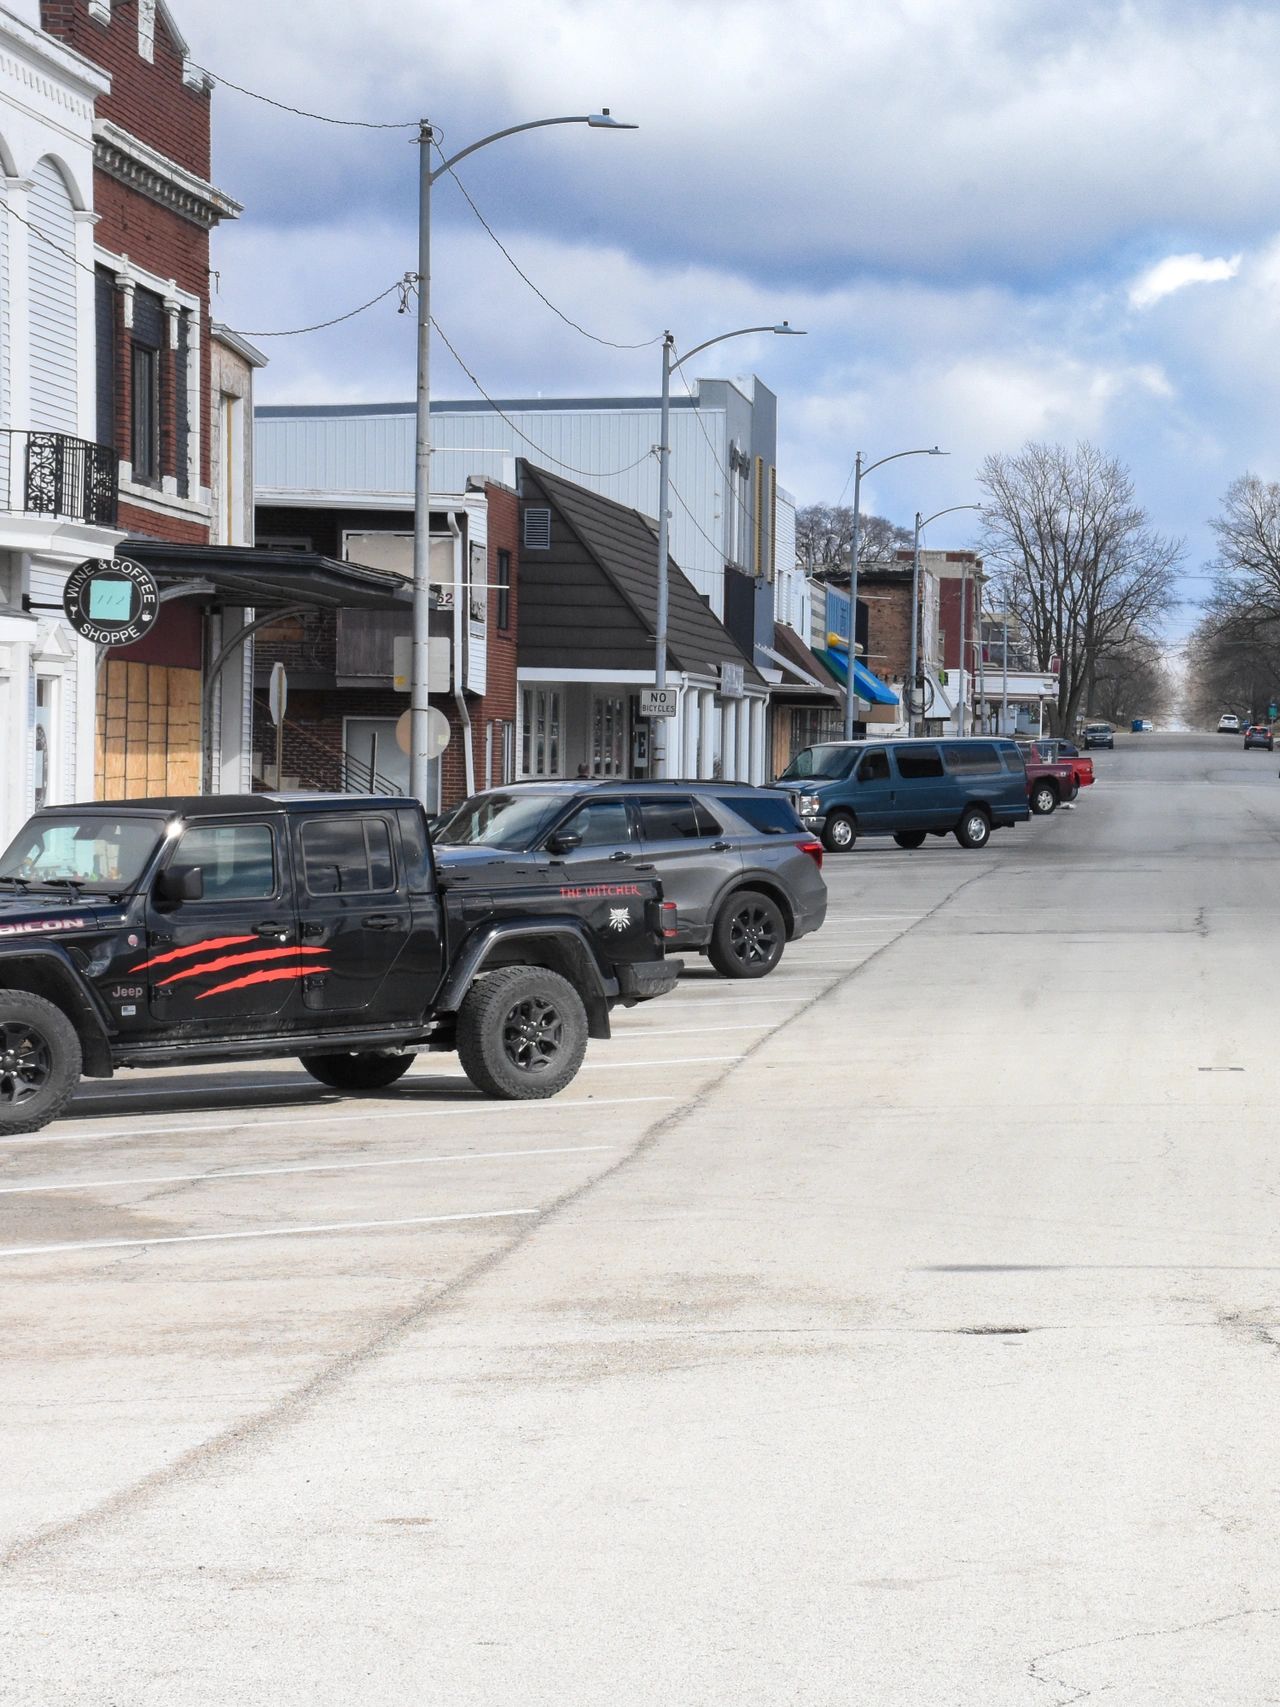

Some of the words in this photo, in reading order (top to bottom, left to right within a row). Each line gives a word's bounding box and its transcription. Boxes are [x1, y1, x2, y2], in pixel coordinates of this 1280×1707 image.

[66, 563, 95, 598] WINE
[98, 558, 108, 570] &
[110, 558, 156, 603] COFFEE
[80, 623, 141, 644] SHOPPE
[650, 692, 667, 703] NO
[642, 704, 675, 713] BICYCLES
[560, 887, 583, 899] THE
[585, 883, 642, 897] WITCHER
[112, 986, 144, 998] Jeep
